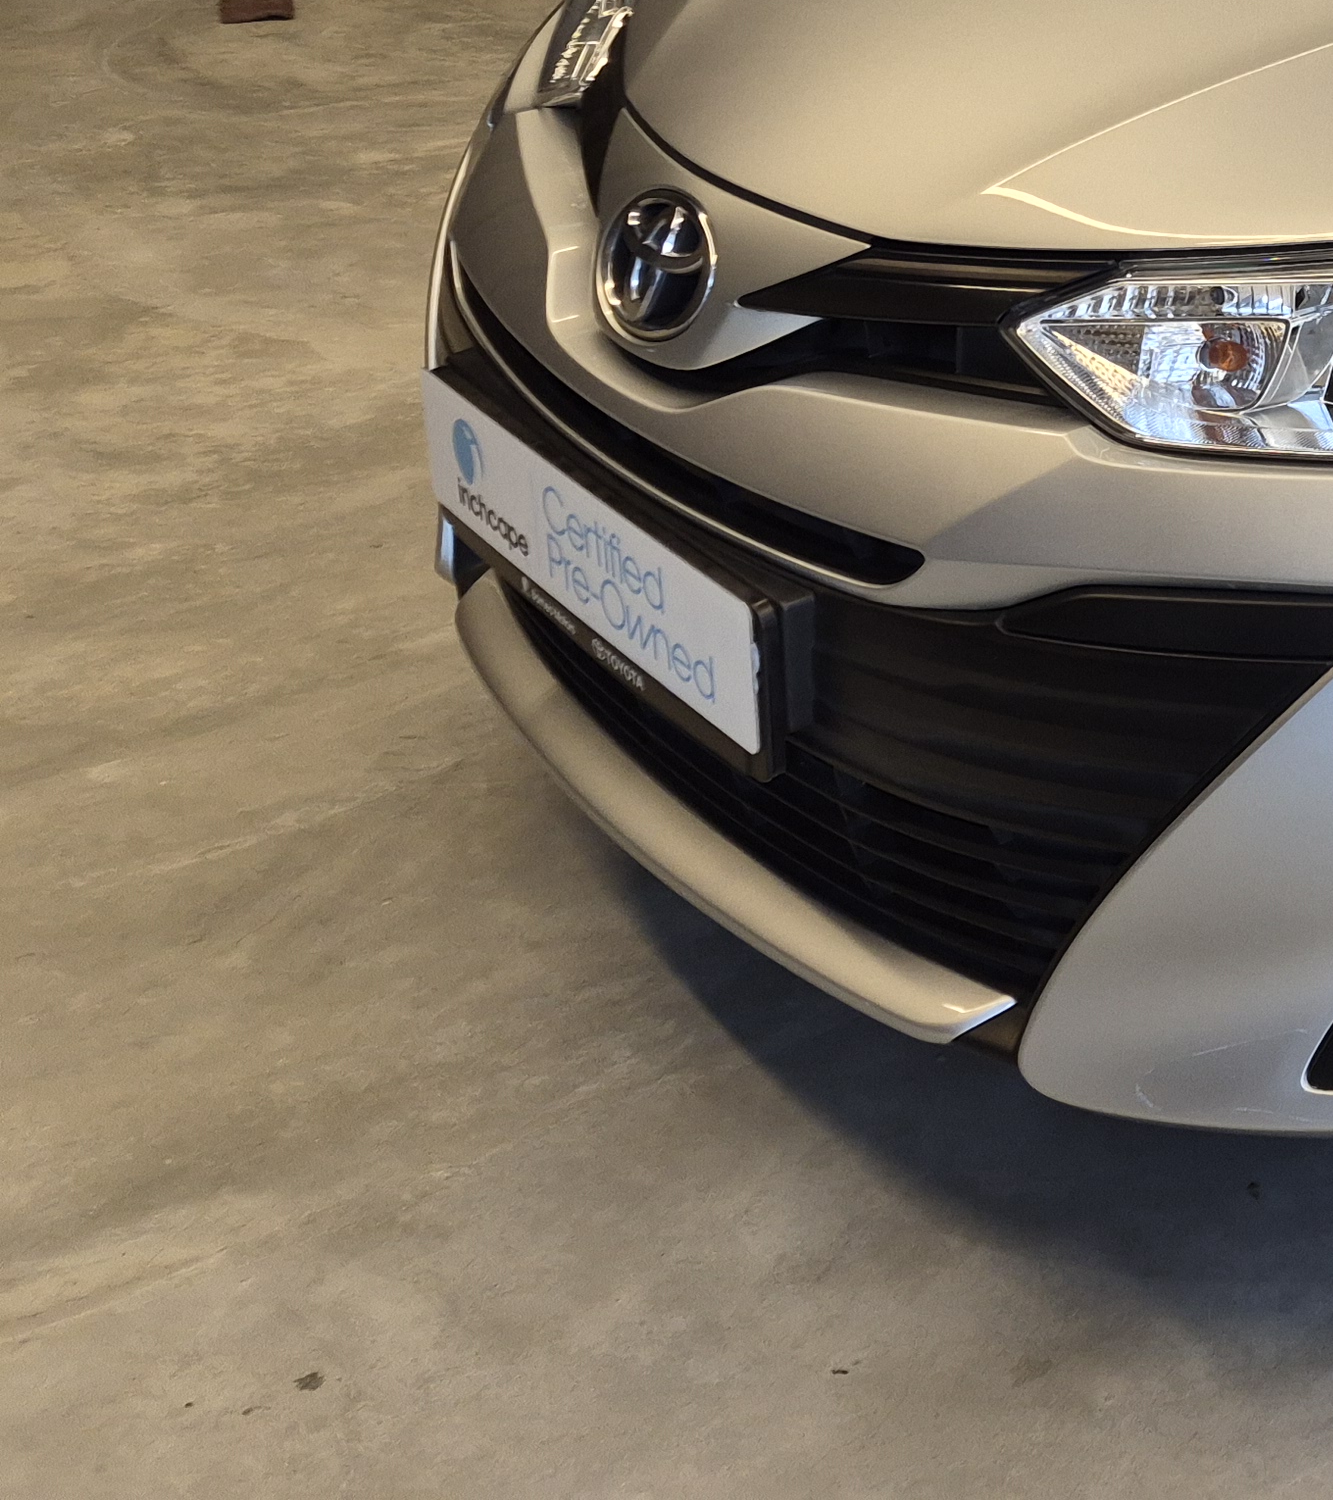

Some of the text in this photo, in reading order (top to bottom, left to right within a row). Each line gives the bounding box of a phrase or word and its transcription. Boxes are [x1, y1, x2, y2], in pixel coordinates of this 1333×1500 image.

[457, 477, 529, 557] inchcape
[542, 486, 665, 614] Certified
[547, 533, 716, 704] Pre-Owned
[605, 651, 646, 691] TOYOTA
